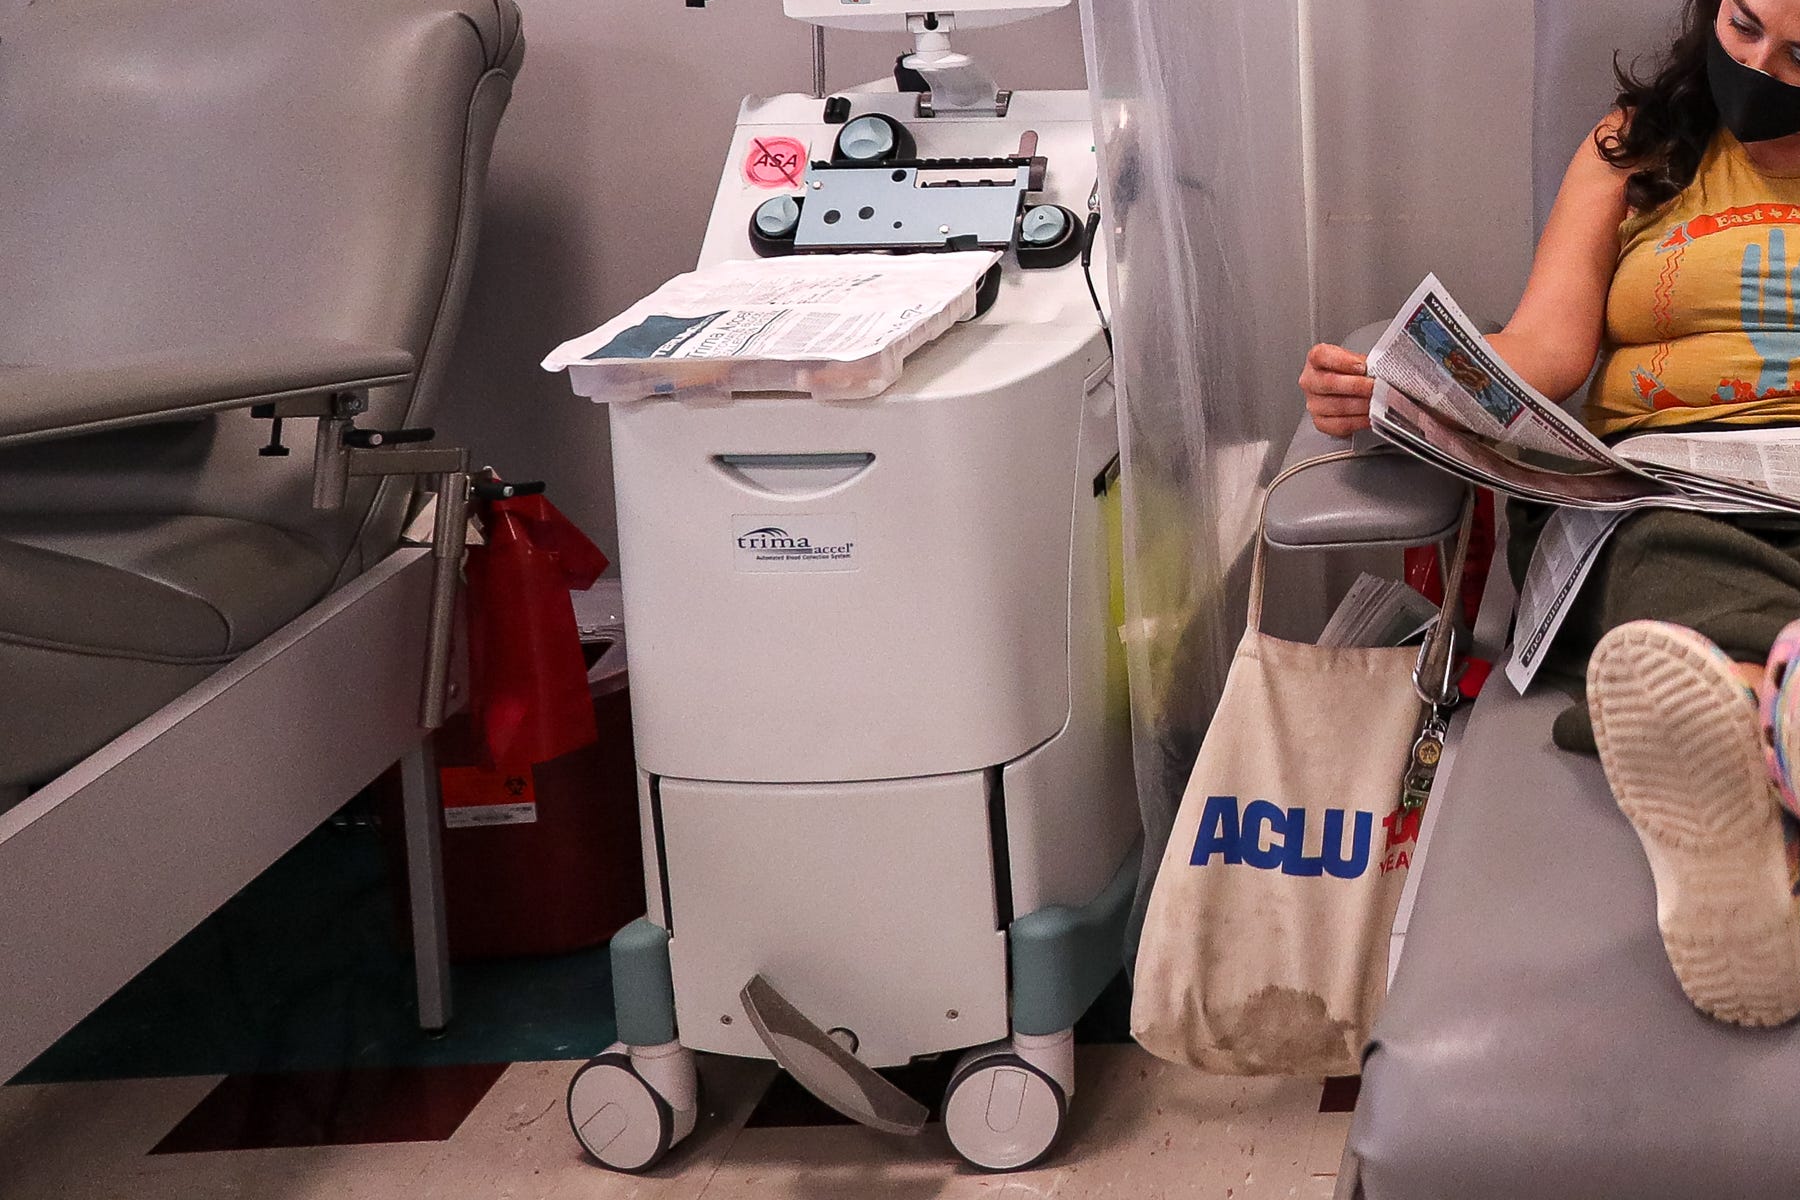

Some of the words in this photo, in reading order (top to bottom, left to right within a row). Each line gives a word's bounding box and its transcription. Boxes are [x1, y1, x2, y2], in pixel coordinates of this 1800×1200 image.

[753, 153, 798, 168] ASA
[1715, 208, 1764, 228] East
[685, 332, 724, 358] Trima
[1431, 297, 1454, 326] WHAT
[1538, 406, 1576, 440] CRUCIAL
[737, 533, 811, 549] trima
[814, 543, 852, 554] accel
[1542, 587, 1568, 630] INSIDE
[1525, 628, 1544, 661] OUT
[1189, 796, 1373, 879] ACLU
[1379, 850, 1414, 877] YEA
